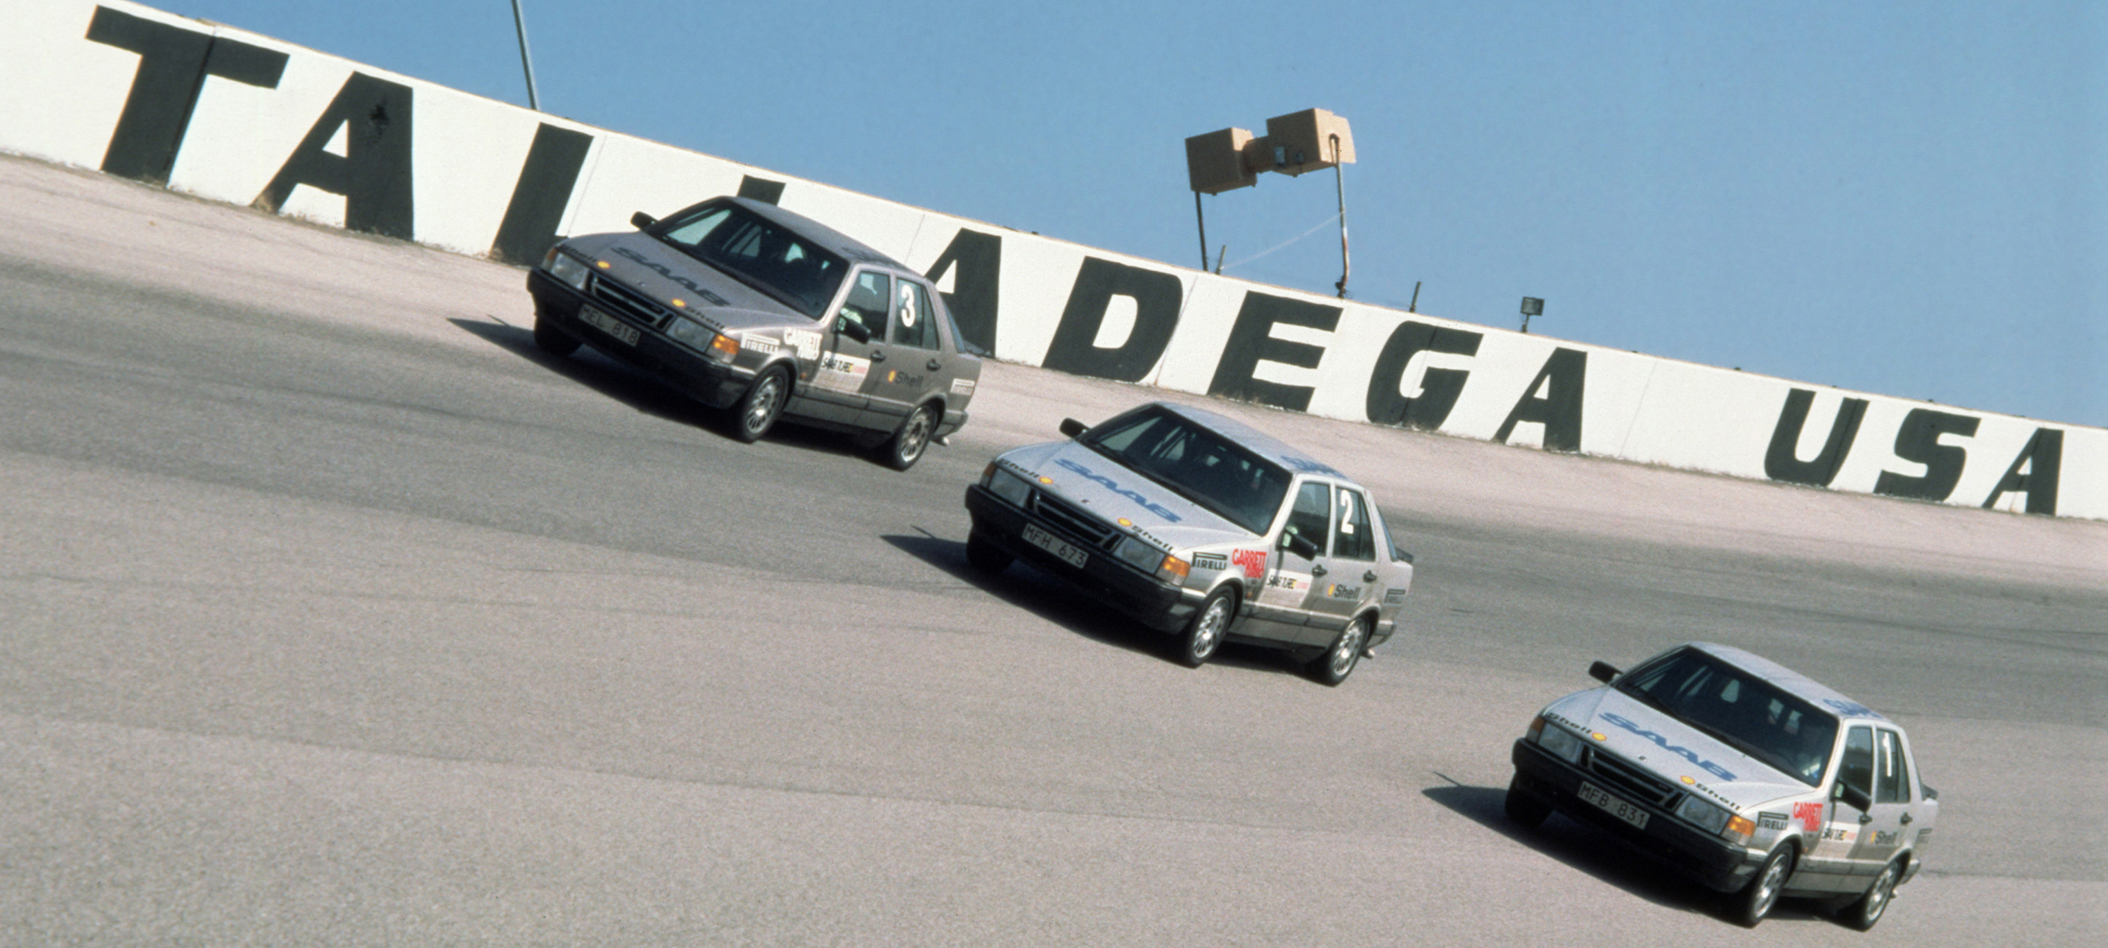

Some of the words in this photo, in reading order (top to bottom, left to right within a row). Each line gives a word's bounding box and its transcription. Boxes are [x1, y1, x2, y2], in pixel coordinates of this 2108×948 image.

[87, 5, 1588, 452] TALADEGA
[1765, 389, 2064, 516] USA
[610, 247, 731, 306] SAAB
[685, 306, 725, 330] Shell
[901, 284, 916, 328] 3
[612, 322, 639, 344] 818
[895, 371, 924, 388] Shell
[1000, 458, 1040, 479] Shell
[1054, 458, 1182, 523] SAAB
[1340, 489, 1354, 534] 2
[1023, 525, 1051, 549] MFH
[1058, 543, 1087, 567] 673
[1131, 525, 1175, 551] Shell
[1191, 551, 1228, 571] PIRELLI
[1333, 584, 1362, 600] Shell
[1549, 711, 1592, 734] Shell
[1598, 712, 1738, 782] SAAB
[1882, 732, 1892, 777] 1
[1580, 782, 1609, 808] MFB
[1617, 801, 1648, 828] 831
[1694, 783, 1741, 811] Shell
[1757, 811, 1789, 831] PIRELLI
